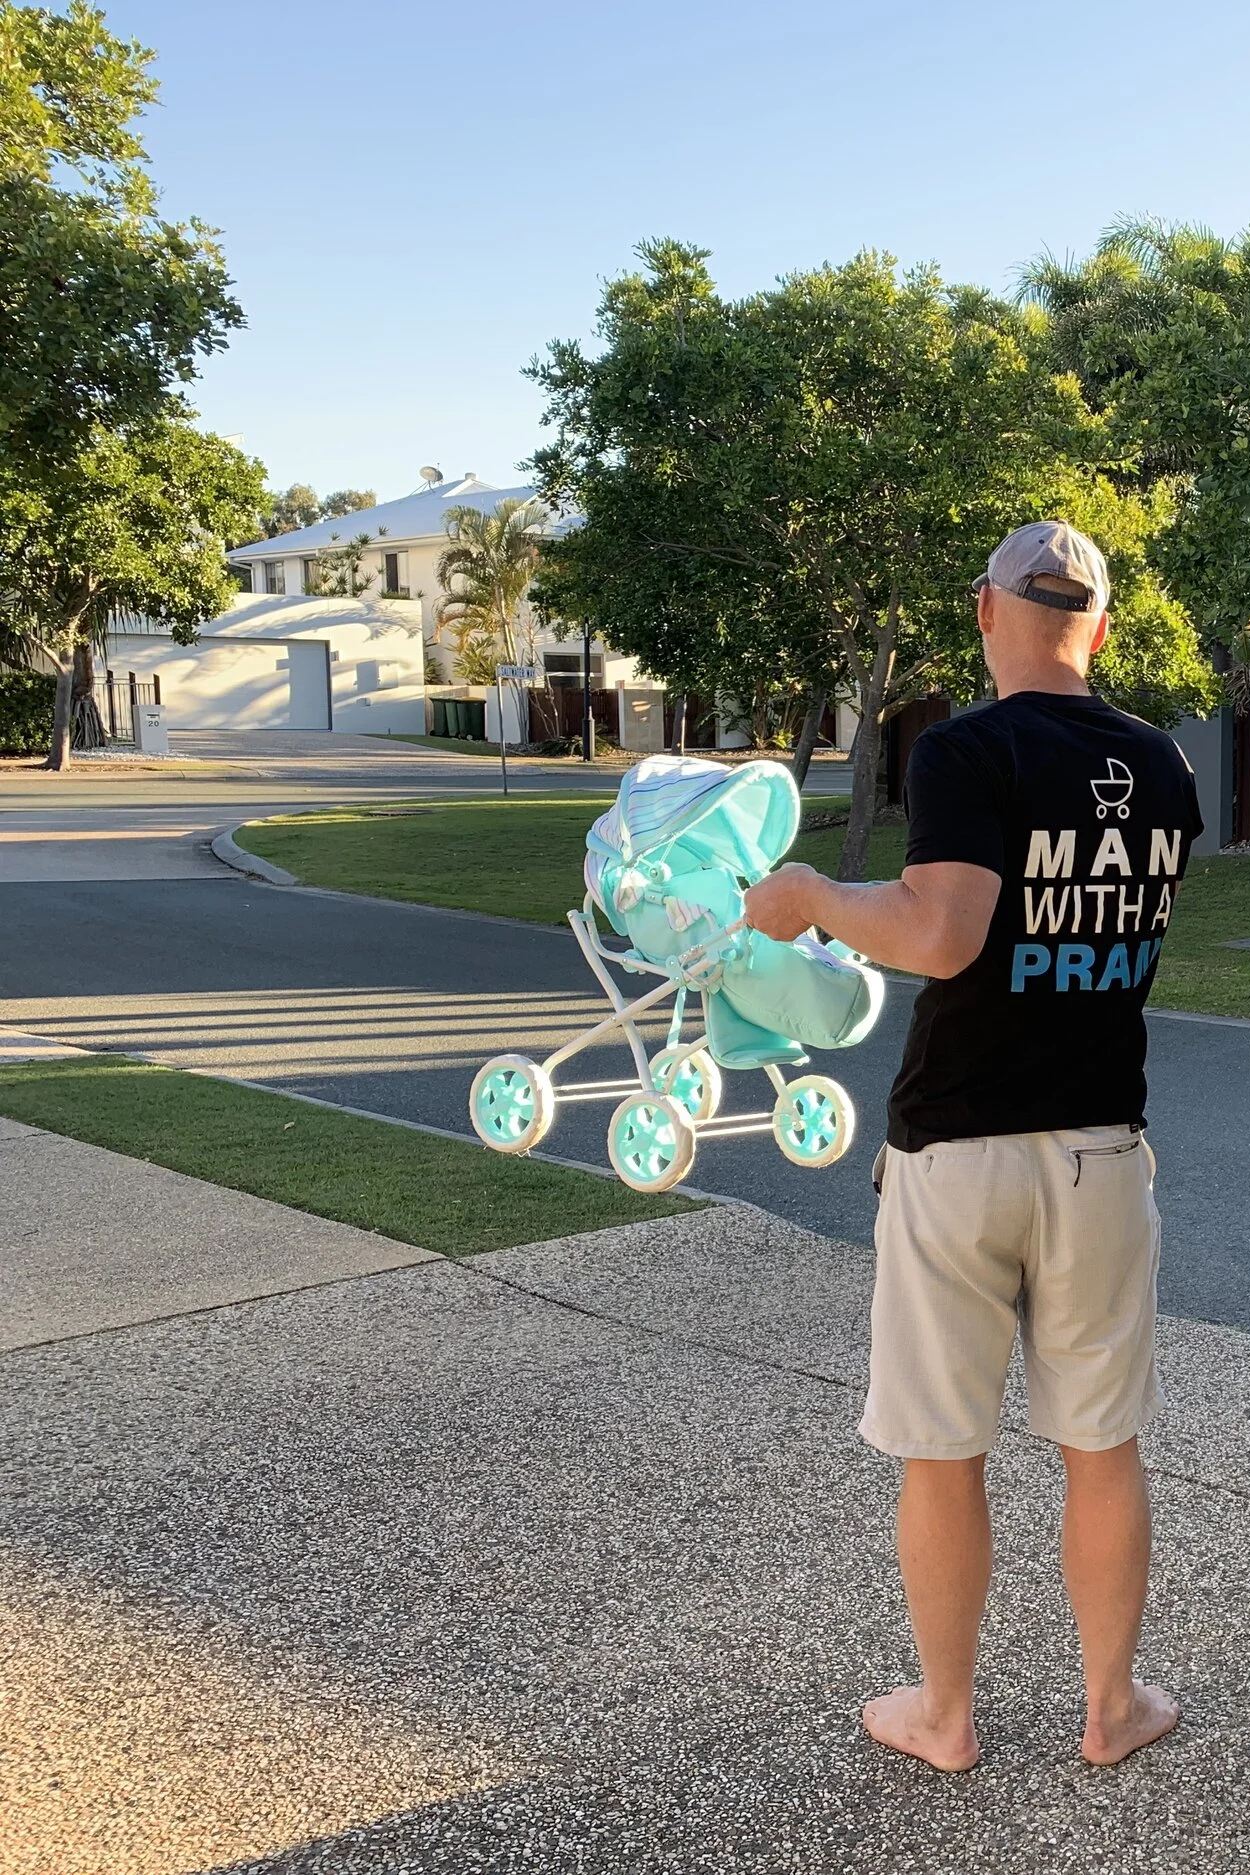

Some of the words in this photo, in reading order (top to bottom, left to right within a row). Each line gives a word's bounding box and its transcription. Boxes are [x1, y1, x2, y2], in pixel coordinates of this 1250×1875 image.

[526, 669, 536, 678] WAY
[1024, 828, 1181, 878] MAN
[1024, 884, 1144, 934] WITH
[1151, 883, 1171, 931] A
